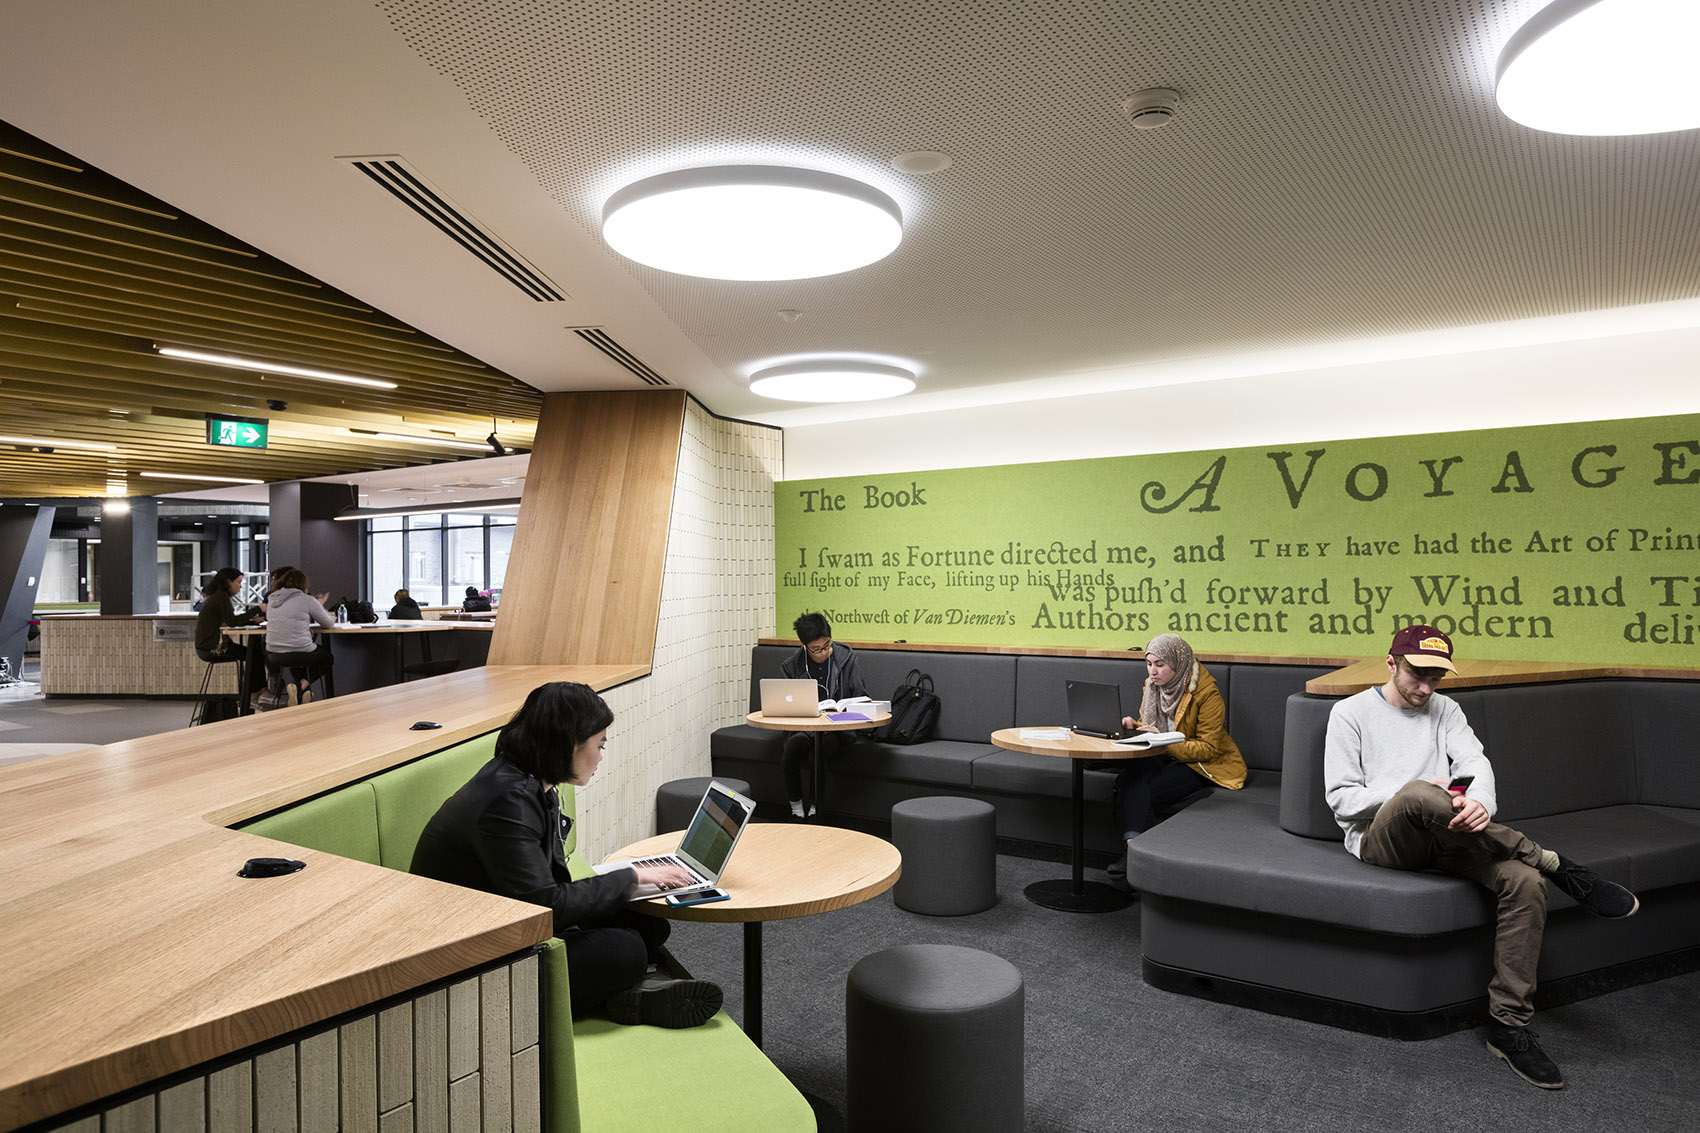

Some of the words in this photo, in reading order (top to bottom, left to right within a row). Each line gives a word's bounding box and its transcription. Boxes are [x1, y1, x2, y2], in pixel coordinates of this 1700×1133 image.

[1139, 454, 1228, 515] A
[1266, 439, 1700, 511] VOYAGE
[799, 487, 847, 513] The
[862, 481, 928, 509] Book
[798, 547, 807, 569] I
[881, 551, 901, 568] as
[906, 545, 995, 568] Fortune
[1000, 540, 1098, 566] directed
[1106, 545, 1157, 569] me,
[1173, 534, 1226, 564] and
[1249, 538, 1332, 559] THEY
[1345, 535, 1401, 557] have
[1413, 532, 1460, 555] had
[1470, 531, 1513, 555] the
[1524, 529, 1573, 553] Art
[1585, 528, 1620, 553] of
[783, 571, 807, 588] full
[844, 571, 862, 588] of
[867, 575, 891, 592] my
[896, 571, 937, 590] Face,
[945, 570, 996, 592] lifting
[999, 574, 1020, 592] up
[1027, 569, 1051, 587] his
[1056, 568, 1116, 588] Hands
[1206, 577, 1331, 607] forward
[1353, 577, 1395, 614] by
[1410, 574, 1524, 608] Wind
[1552, 575, 1626, 608] and
[893, 608, 911, 625] of
[913, 607, 944, 626] Van
[1031, 601, 1151, 632] Authors
[1167, 604, 1290, 635] ancient
[1308, 605, 1376, 637] and
[1390, 604, 1556, 640] modern
[1623, 610, 1700, 647] deli
